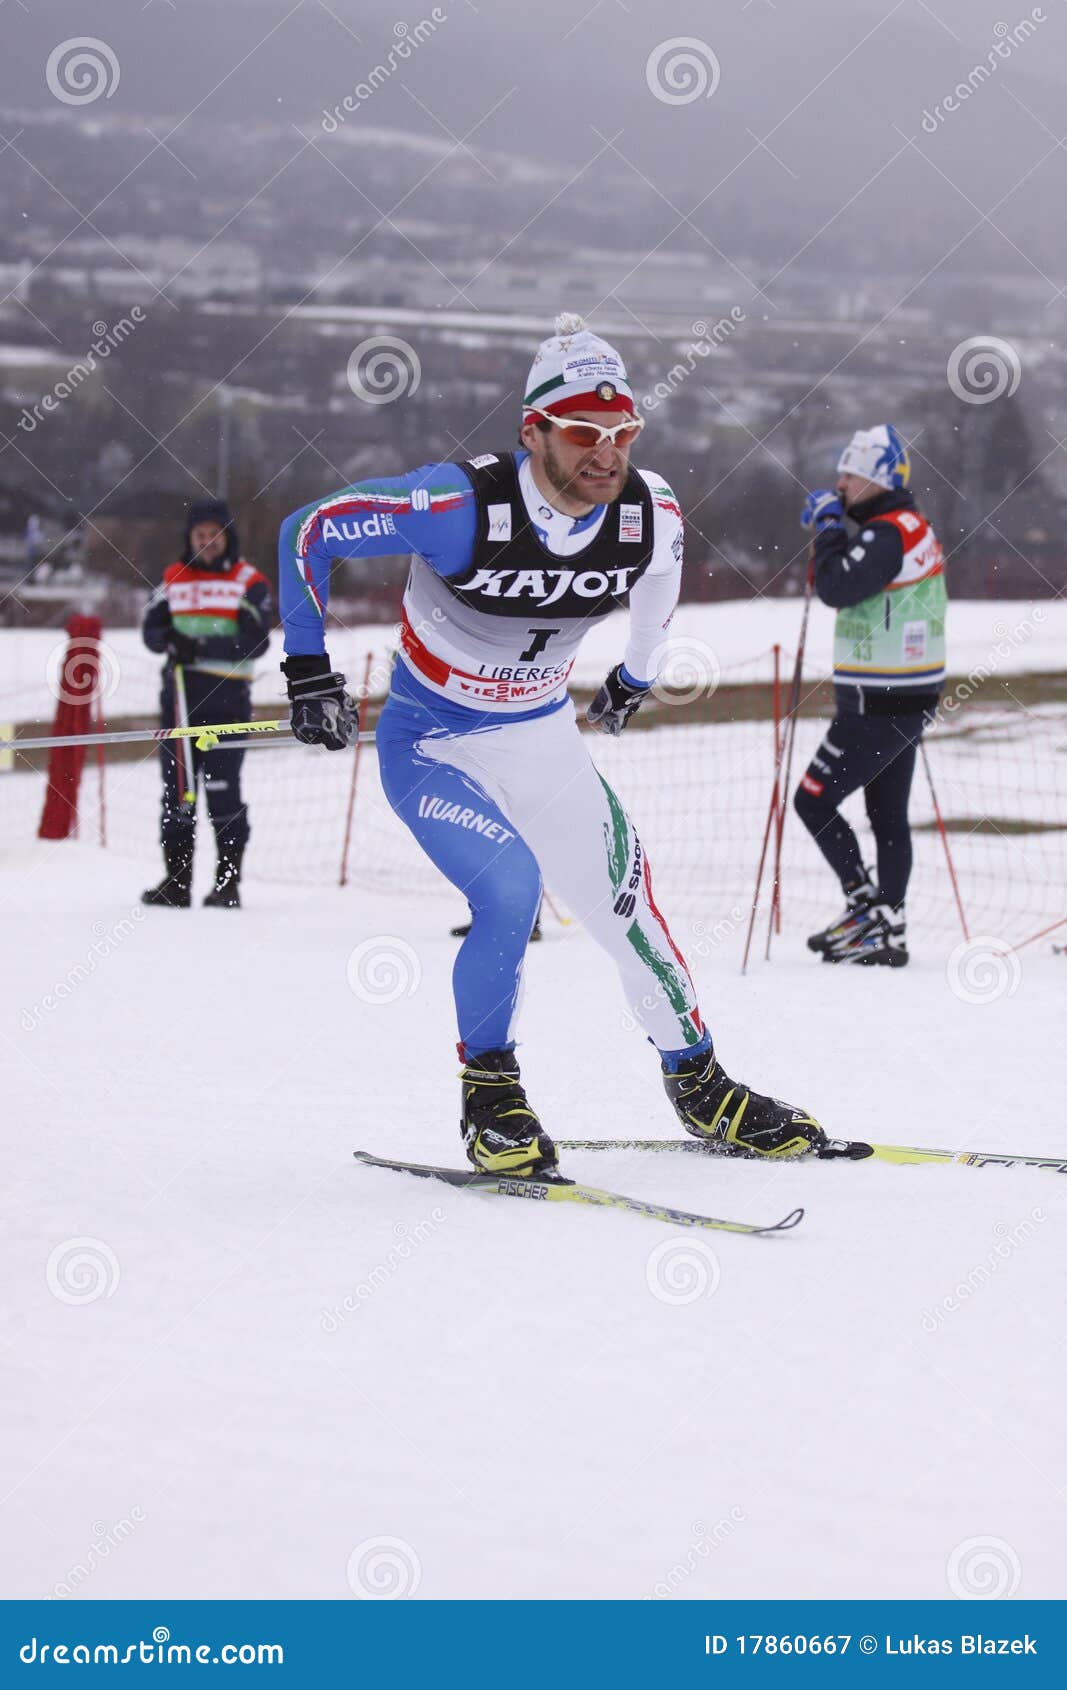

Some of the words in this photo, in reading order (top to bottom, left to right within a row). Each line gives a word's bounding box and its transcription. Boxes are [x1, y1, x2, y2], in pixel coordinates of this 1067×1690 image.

[322, 513, 390, 543] Audi
[454, 568, 640, 608] KAJOT
[478, 659, 567, 681] LIBEREC
[629, 824, 642, 890] spor
[497, 1179, 549, 1201] FISCHER
